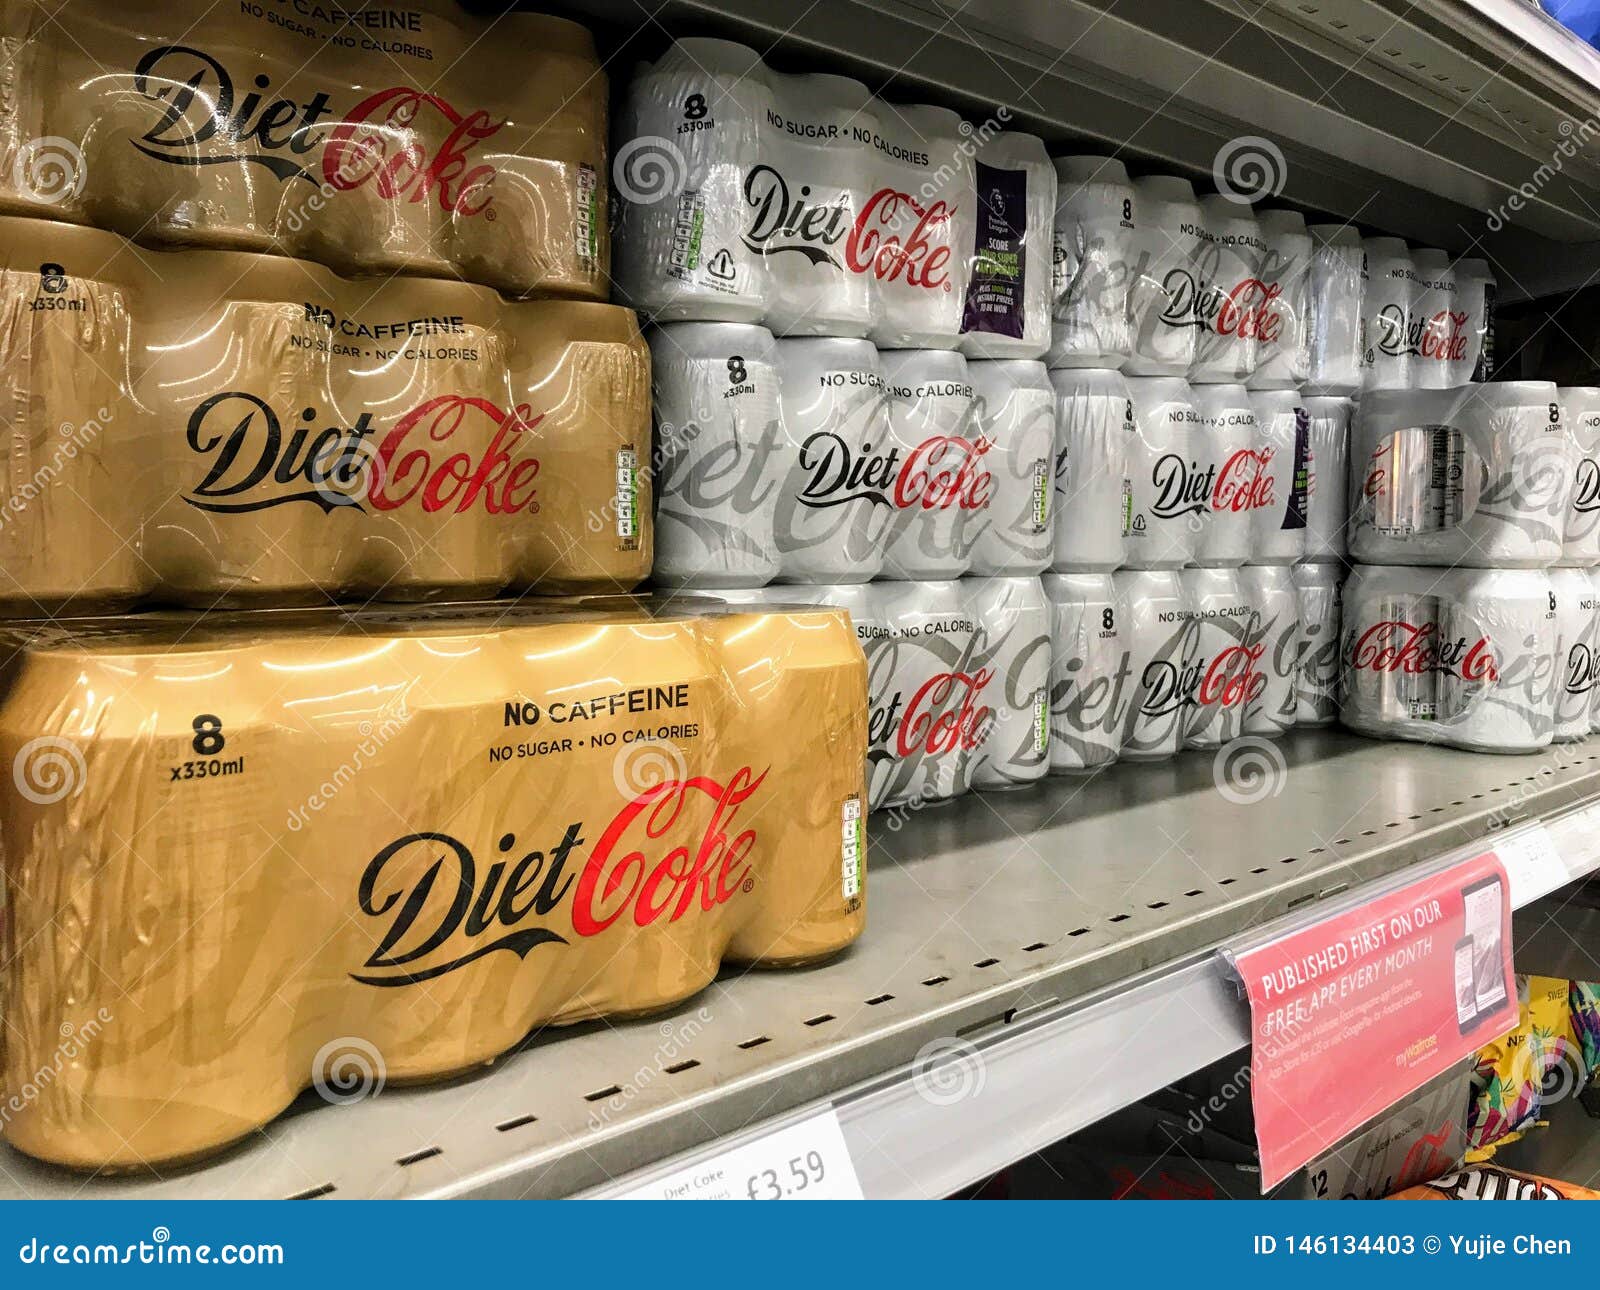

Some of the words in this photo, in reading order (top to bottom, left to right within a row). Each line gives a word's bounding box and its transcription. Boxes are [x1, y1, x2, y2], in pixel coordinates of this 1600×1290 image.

[240, 3, 263, 18] NO
[267, 11, 317, 39] SUGAR
[332, 36, 356, 49] NO
[361, 41, 434, 61] CALORIES
[294, 0, 422, 32] CAFFEINE
[683, 93, 708, 120] 8
[131, 46, 332, 187] Diet
[321, 87, 508, 217] Coke
[766, 109, 783, 129] NO
[787, 121, 838, 138] SUGAR
[853, 127, 871, 144] NO
[873, 135, 929, 166] CALORIES
[739, 164, 851, 270] Diet
[845, 187, 958, 290] Coke
[1122, 199, 1132, 221] 8
[988, 237, 1009, 251] SCORE
[1180, 224, 1195, 235] NO
[1222, 235, 1236, 245] NO
[40, 263, 68, 293] 8
[304, 302, 336, 329] NO
[340, 316, 466, 340] CAFFEINE
[1158, 268, 1224, 333] Diet
[1216, 278, 1283, 342] Coke
[291, 335, 312, 349] NO
[404, 348, 479, 361] CALORIES
[1377, 304, 1425, 357] Diet
[1421, 311, 1469, 361] Coke
[726, 355, 747, 385] 8
[819, 374, 845, 388] NO
[850, 373, 887, 390] SUGA
[892, 385, 912, 398] NO
[1168, 411, 1184, 423] NO
[1548, 402, 1560, 423] 8
[181, 391, 374, 516] Diet
[369, 395, 546, 515] Coke
[795, 431, 899, 510] Diet
[893, 435, 998, 511] Coke
[1150, 454, 1215, 519] Diet
[1210, 447, 1277, 513] Coke
[1102, 608, 1114, 630] 8
[1158, 613, 1175, 623] NO
[1201, 610, 1216, 619] NO
[1580, 600, 1592, 609] NO
[857, 625, 890, 639] SUGAR
[901, 626, 920, 638] NO
[924, 620, 974, 635] CALORIES
[1352, 622, 1438, 674] Coke
[1139, 658, 1205, 716] Diet
[1199, 644, 1267, 705] Coke
[504, 702, 540, 727] NO
[549, 684, 689, 724] CAFFEINE
[896, 667, 996, 758] Coke
[192, 713, 225, 755] 8
[489, 746, 513, 763] NO
[517, 739, 572, 758] SUGAR
[591, 732, 616, 748] NO
[622, 723, 699, 743] CALORIES
[170, 756, 244, 782] x330ml
[349, 820, 584, 988] Diet
[571, 764, 771, 937] Coke
[1261, 942, 1348, 999] PUBLISHED
[1350, 923, 1388, 959] FIRST
[1390, 914, 1413, 940] ON
[1414, 899, 1443, 929] OUR
[1266, 998, 1304, 1034] FREE
[1309, 982, 1337, 1015] APP
[1340, 959, 1383, 997] EVERY
[1384, 936, 1433, 977] MONTH
[693, 1169, 725, 1187] Coke
[747, 1150, 825, 1200] £3.59
